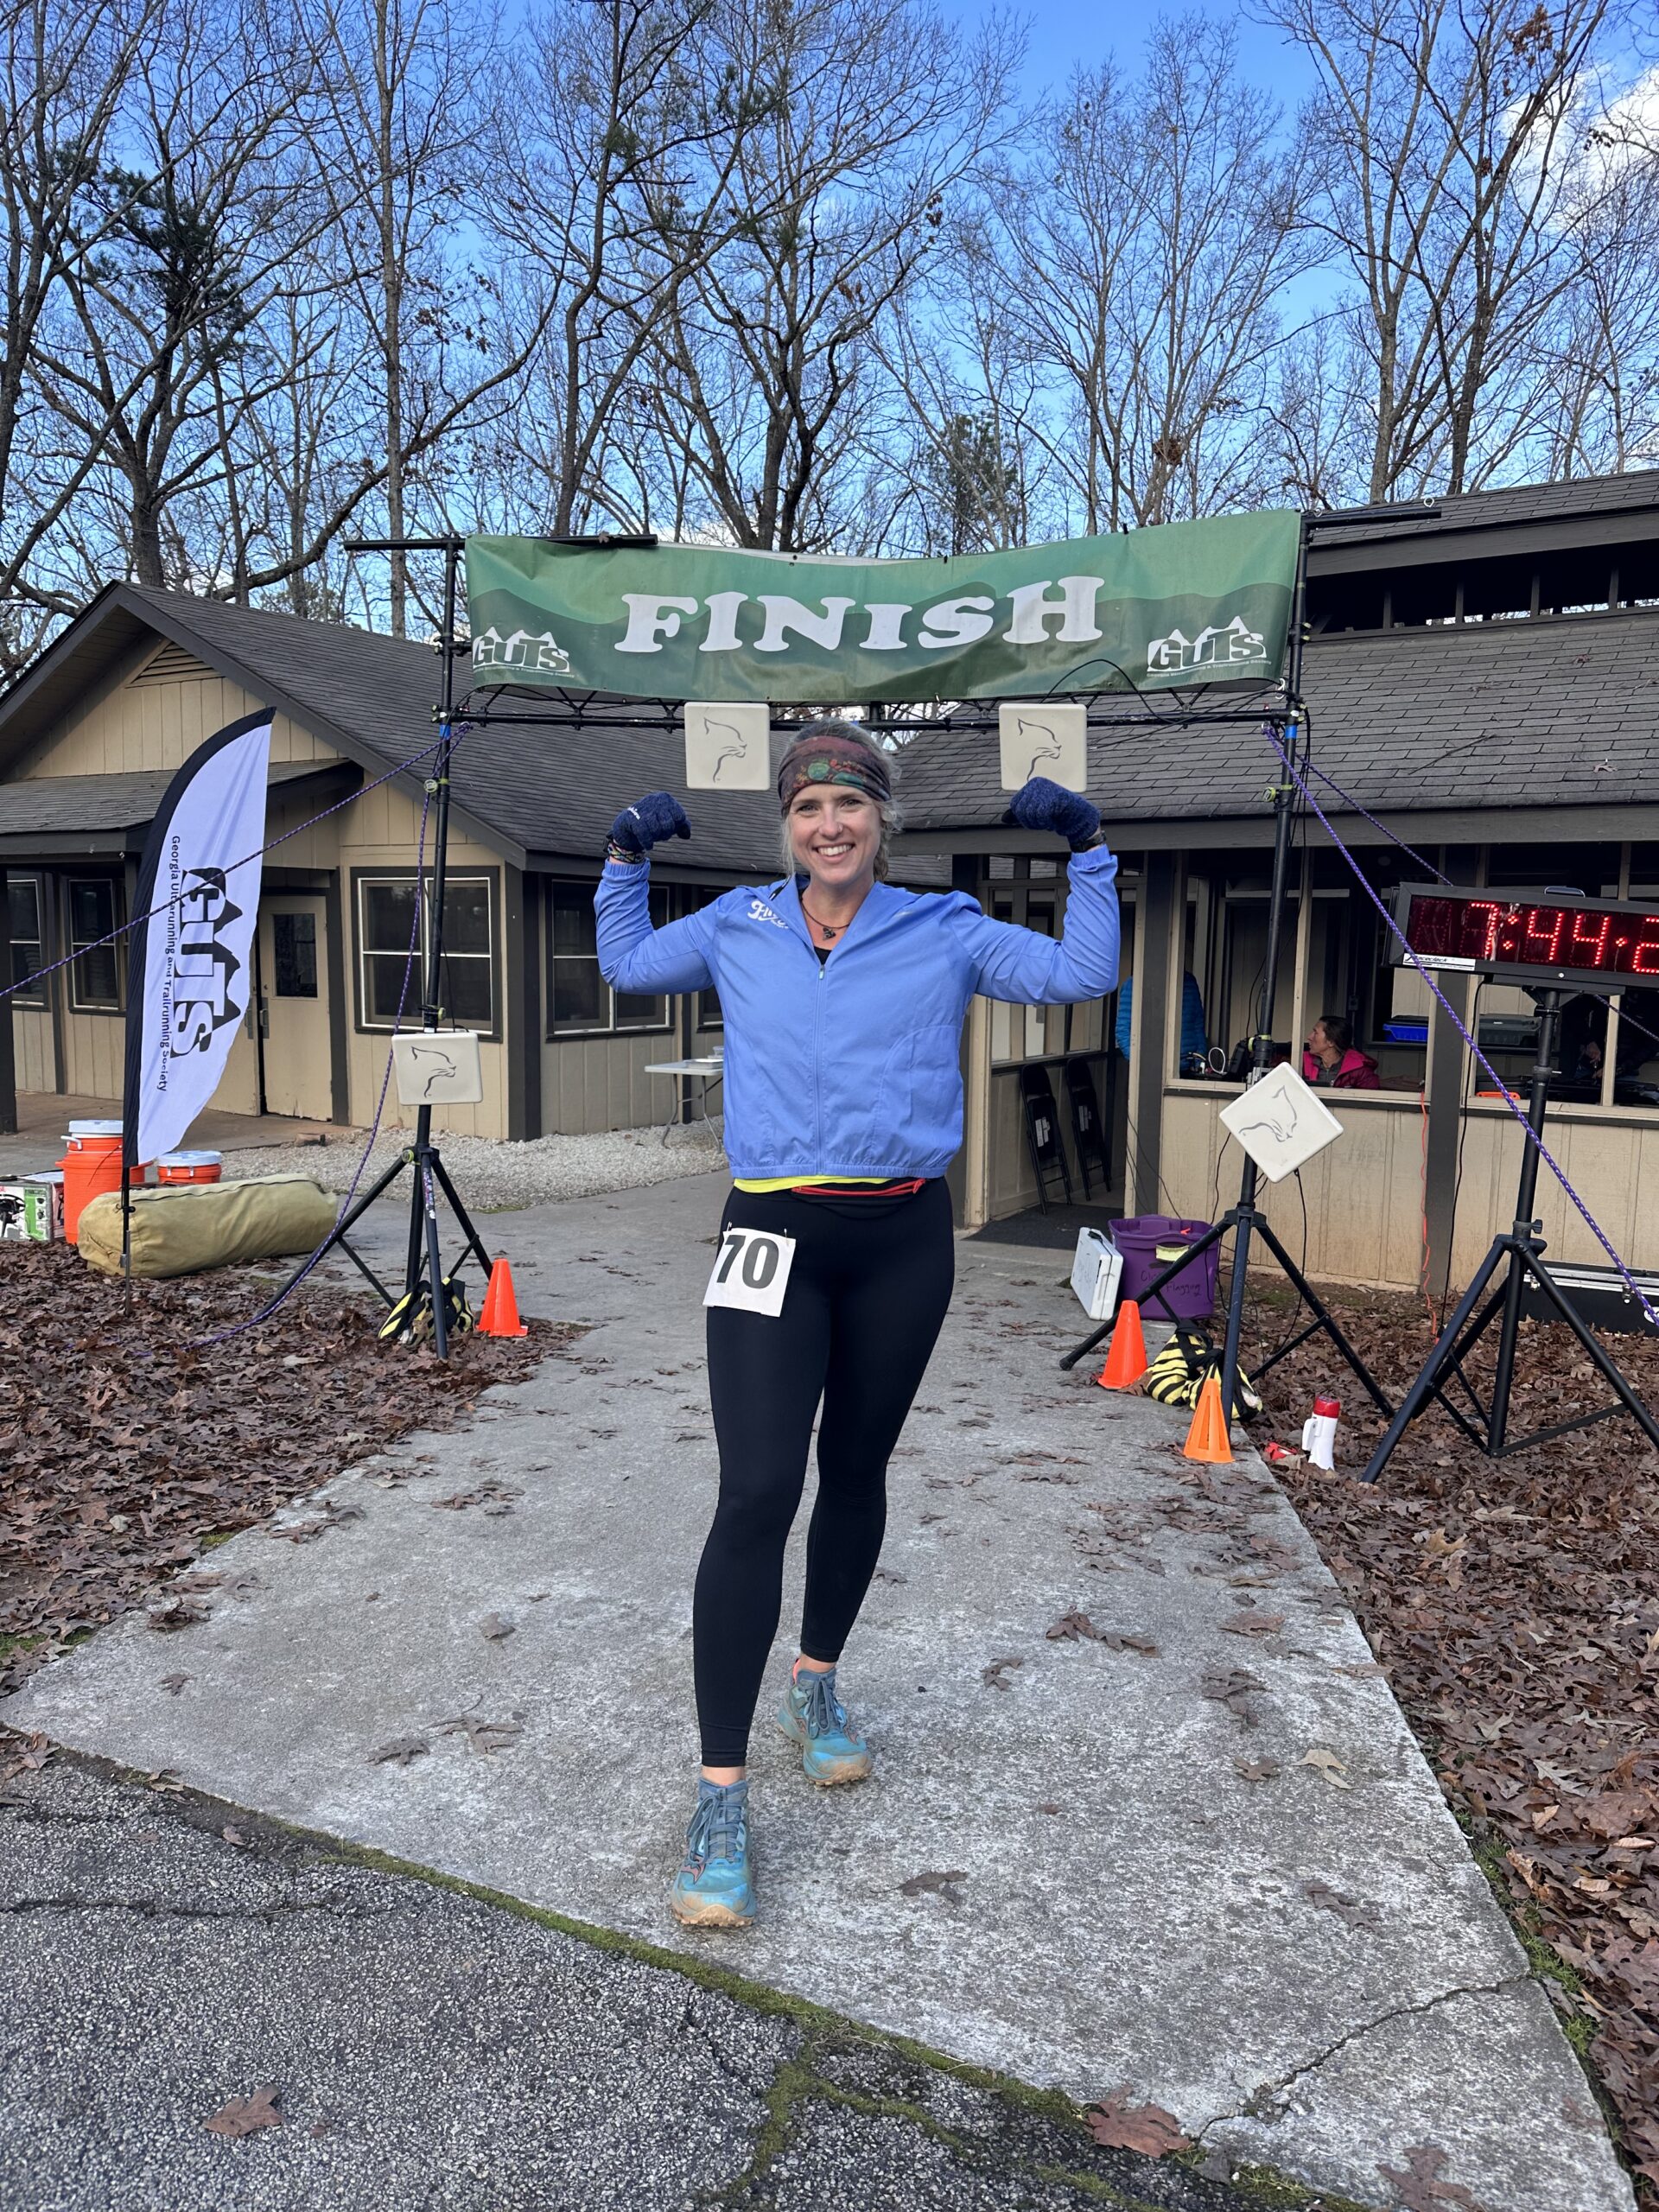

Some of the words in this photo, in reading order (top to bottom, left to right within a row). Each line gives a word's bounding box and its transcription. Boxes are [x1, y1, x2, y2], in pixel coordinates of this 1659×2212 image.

[614, 575, 1105, 652] FINISH
[472, 634, 570, 672] GUTS
[1147, 627, 1268, 672] GUTS
[169, 836, 181, 880] Georgia
[164, 882, 180, 955] Ultarunning
[166, 957, 175, 977] and
[170, 867, 226, 1058] GUTS
[160, 981, 172, 1048] Trailrunning
[156, 1050, 169, 1092] Society
[716, 1234, 779, 1289] 70
